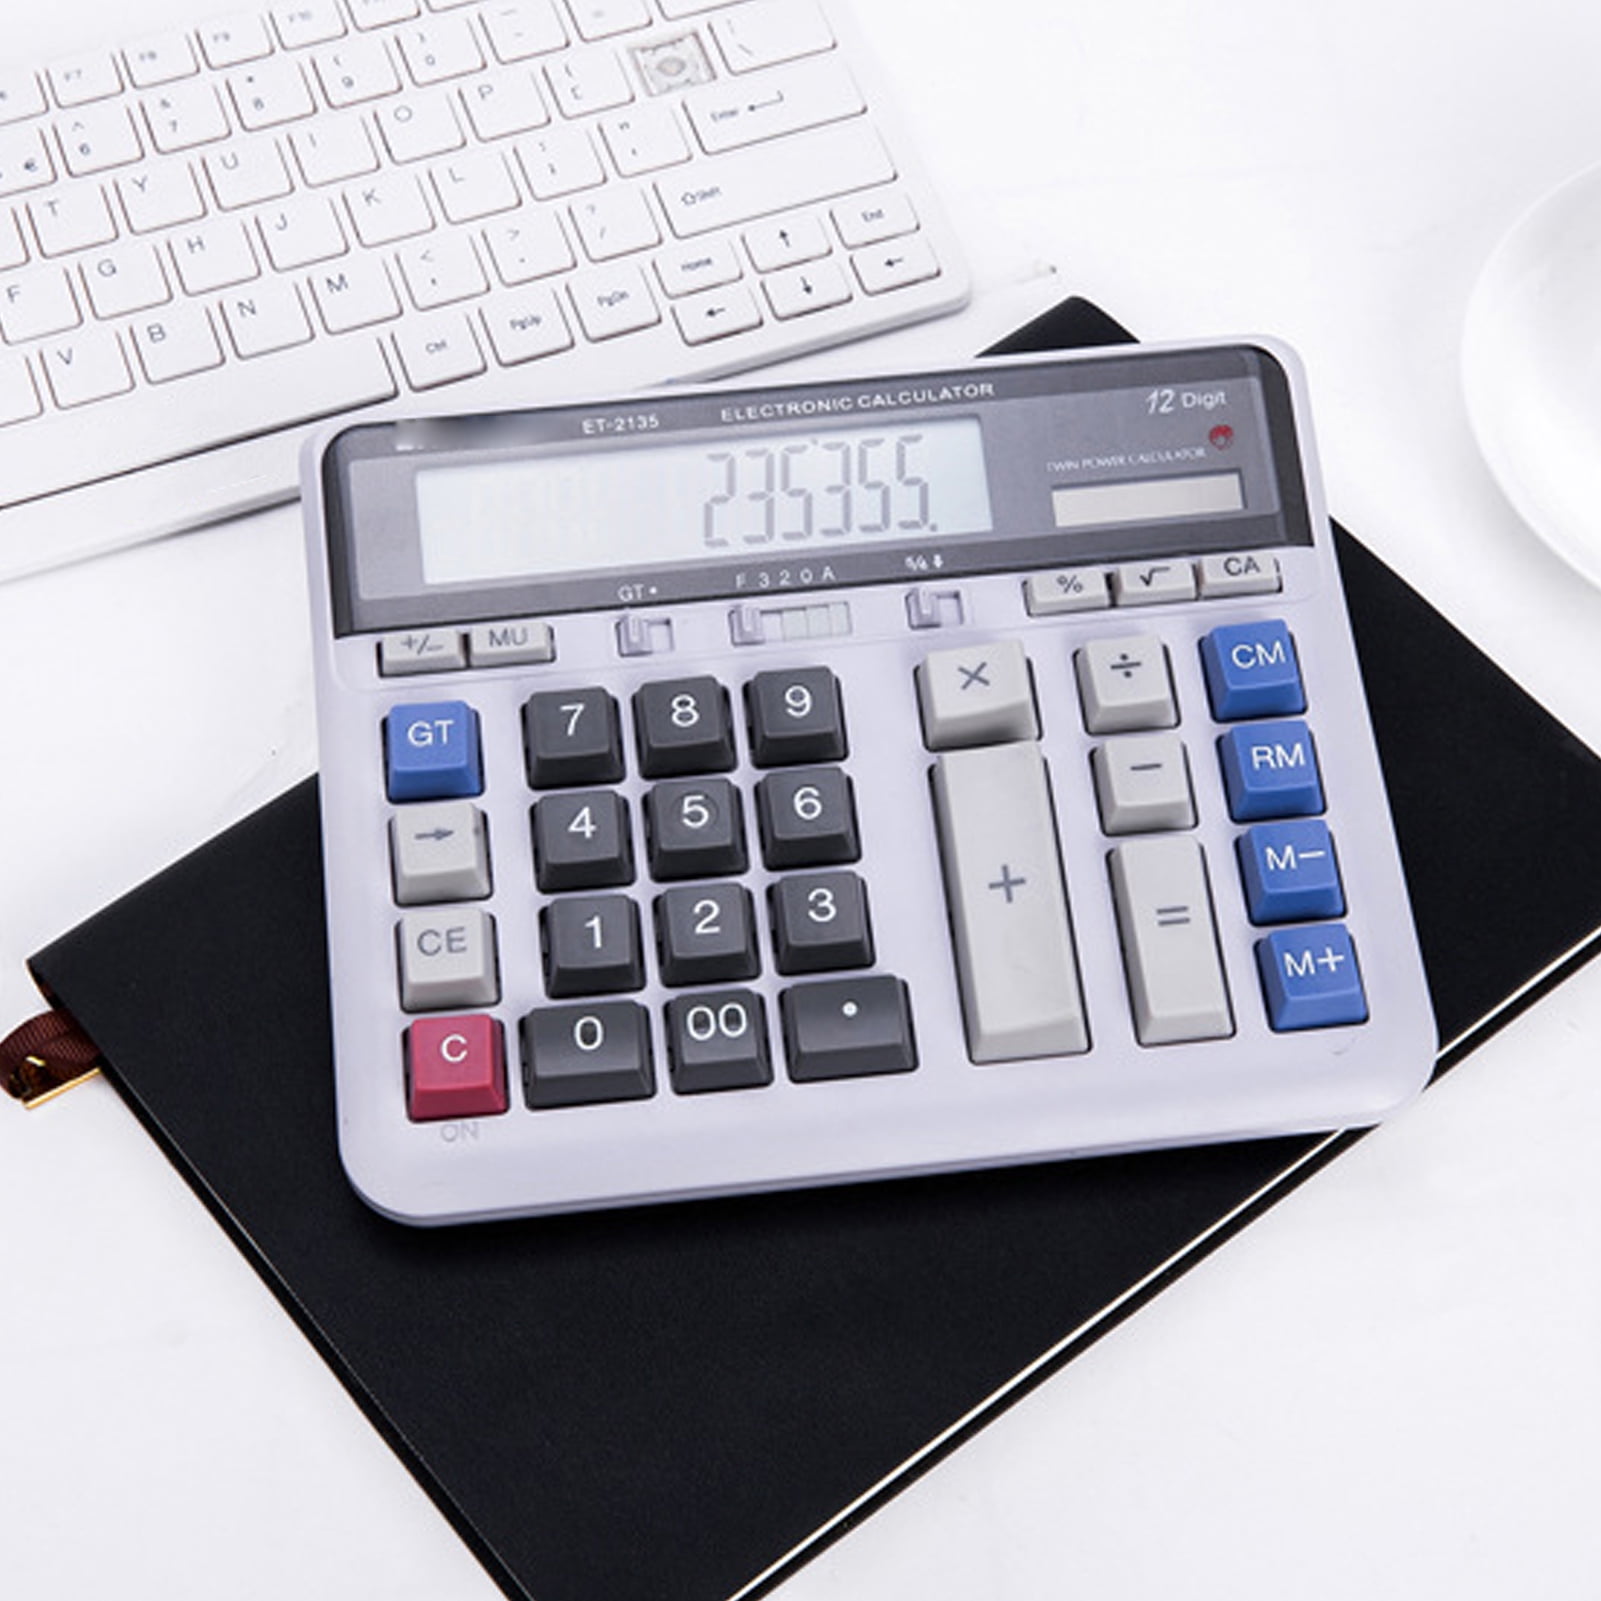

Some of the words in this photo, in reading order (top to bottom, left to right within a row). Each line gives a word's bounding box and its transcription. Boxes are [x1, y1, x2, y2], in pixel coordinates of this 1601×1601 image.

[477, 84, 494, 100] P
[393, 105, 413, 123] O
[710, 107, 739, 121] Enter
[219, 151, 240, 171] U
[132, 176, 148, 193] Y
[447, 167, 465, 184] L
[362, 188, 380, 206] K
[697, 186, 721, 201] Shift
[46, 199, 58, 217] T
[861, 208, 884, 223] End
[275, 212, 288, 231] J
[186, 235, 205, 254] H
[97, 258, 117, 277] G
[681, 257, 713, 271] Home
[6, 284, 20, 303] F
[325, 273, 349, 293] M
[237, 299, 257, 317] N
[146, 323, 167, 344] B
[56, 348, 73, 366] V
[582, 414, 660, 435] ET-2135
[721, 395, 853, 423] ELECTRONIC
[857, 382, 996, 410] CALCULATOR
[1146, 388, 1175, 414] 12
[1181, 391, 1226, 410] Digit
[1047, 460, 1080, 472] TWIN
[1081, 455, 1125, 468] POWER
[1127, 447, 1206, 465] CALCULATOR
[1223, 556, 1261, 577] CA
[617, 584, 644, 602] GT
[488, 628, 527, 647] MU
[1232, 643, 1286, 669] CM
[671, 694, 700, 727] 8
[785, 685, 812, 718] 9
[560, 703, 585, 737] 7
[407, 719, 454, 748] GT
[1252, 744, 1306, 771] RM
[682, 795, 709, 829] 5
[793, 787, 822, 820] 6
[568, 806, 597, 839] 4
[808, 888, 837, 922] 3
[693, 899, 721, 935] 2
[416, 926, 467, 957] CE
[585, 915, 602, 949] 1
[1284, 947, 1345, 977] M+
[686, 1002, 748, 1042] 00
[574, 1016, 603, 1051] 0
[441, 1033, 468, 1063] C
[438, 1121, 479, 1143] ON
